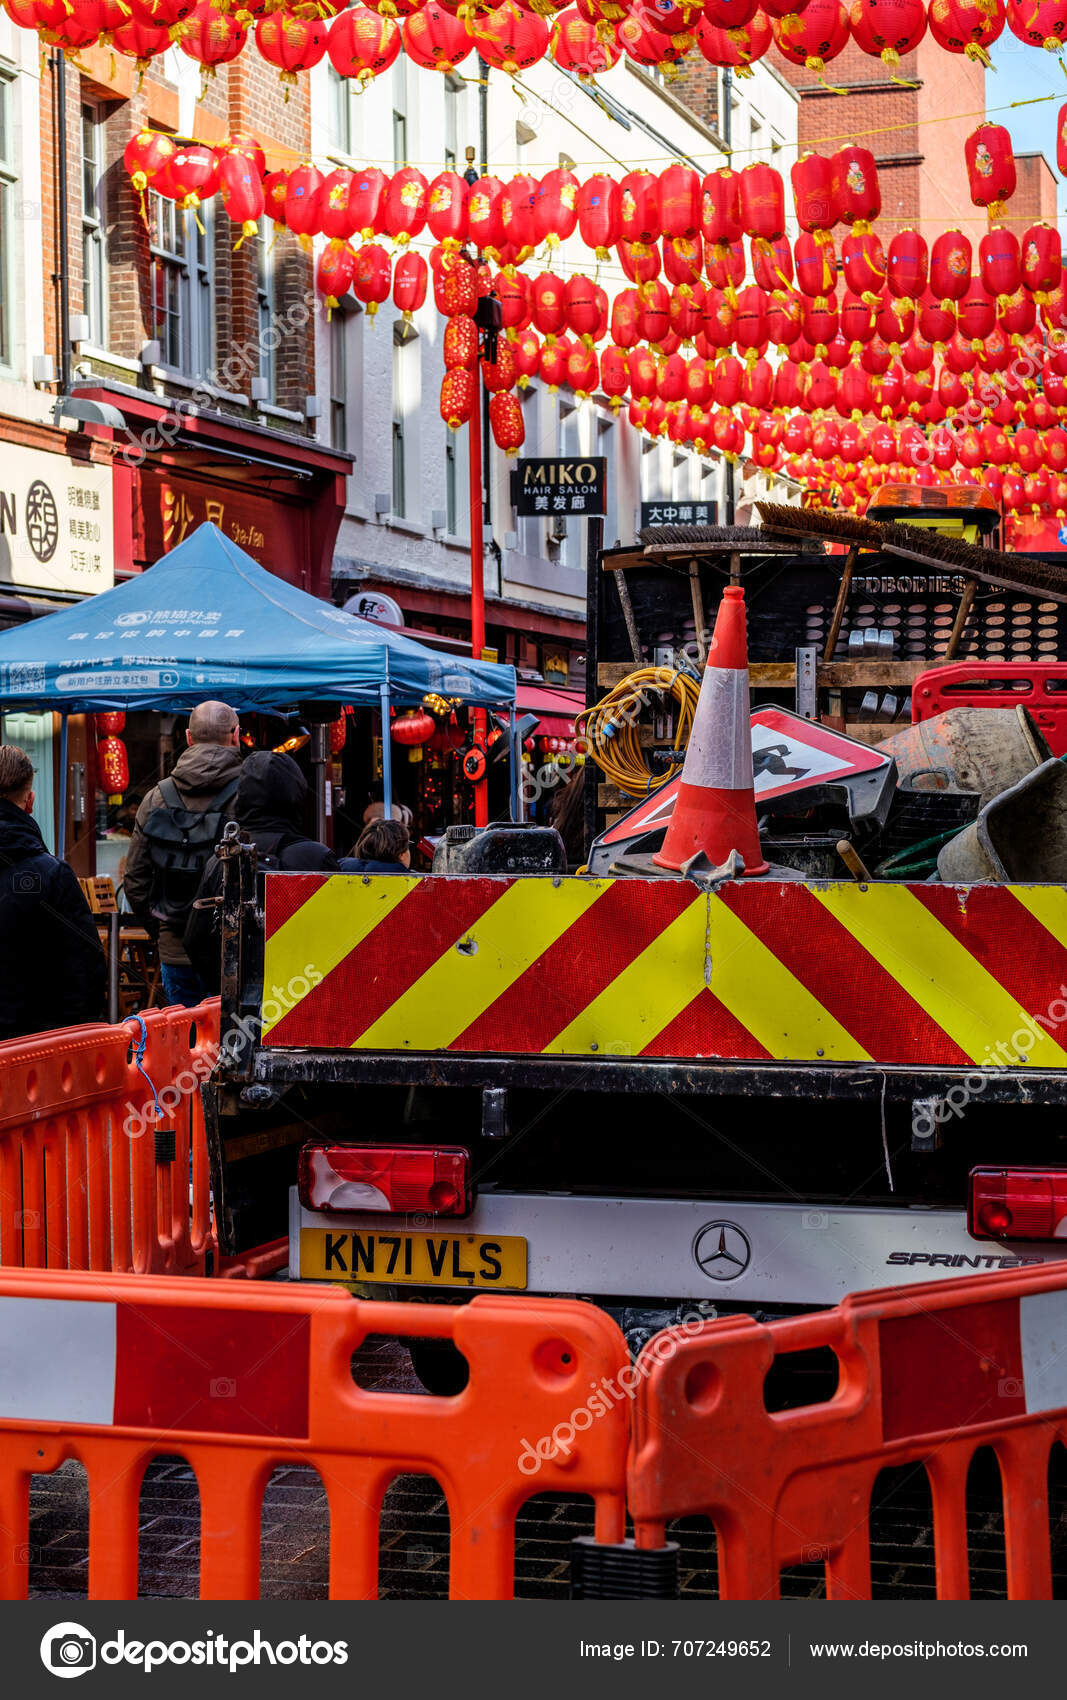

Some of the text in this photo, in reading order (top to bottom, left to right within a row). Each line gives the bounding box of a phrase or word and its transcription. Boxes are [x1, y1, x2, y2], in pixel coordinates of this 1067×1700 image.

[524, 463, 597, 485] MIKO
[524, 485, 597, 495] HAIR SALON
[534, 495, 586, 511] 美发廊
[325, 1233, 503, 1280] KN71 VLS
